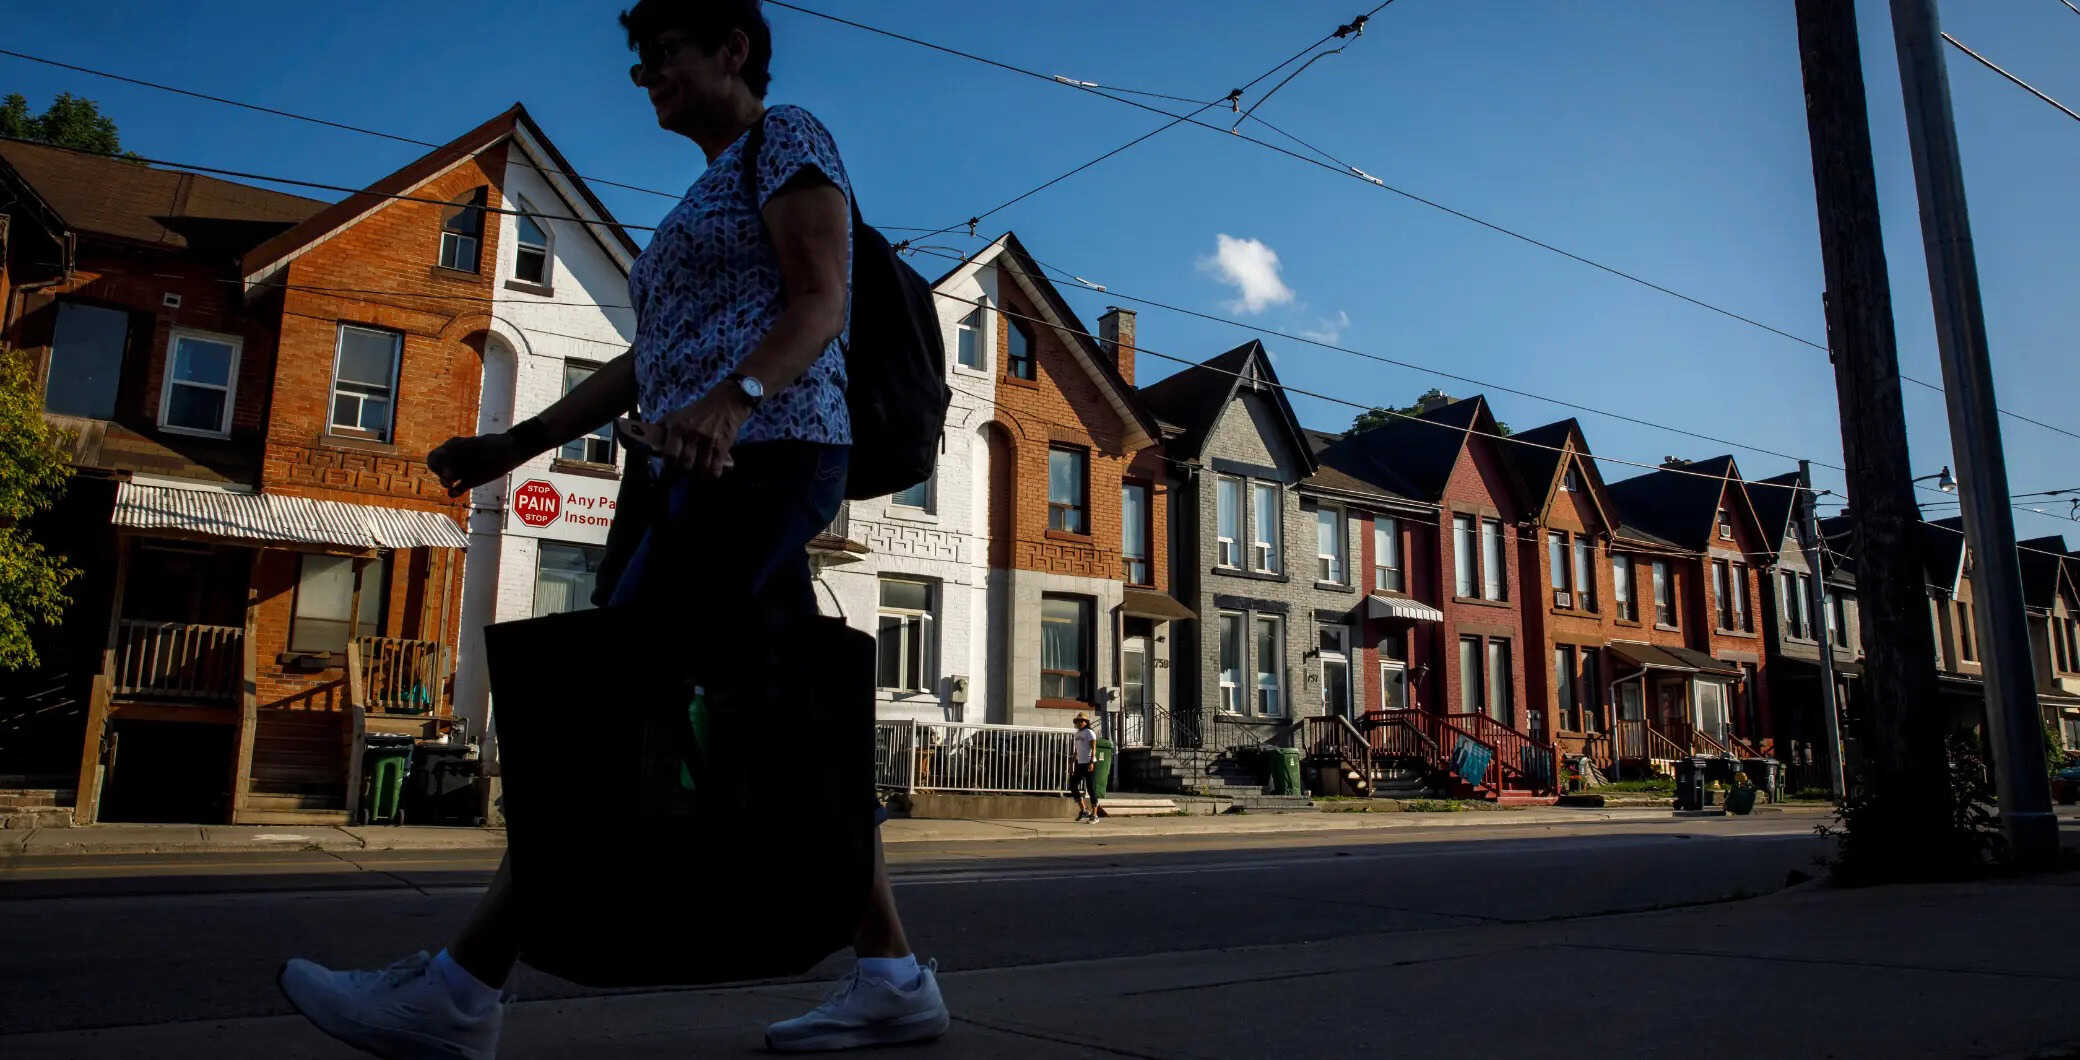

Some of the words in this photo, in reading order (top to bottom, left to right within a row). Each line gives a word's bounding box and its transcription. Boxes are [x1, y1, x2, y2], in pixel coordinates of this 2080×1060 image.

[527, 485, 550, 493] STOP
[518, 494, 556, 513] PAIN
[567, 492, 595, 509] Any
[525, 513, 548, 522] STOP
